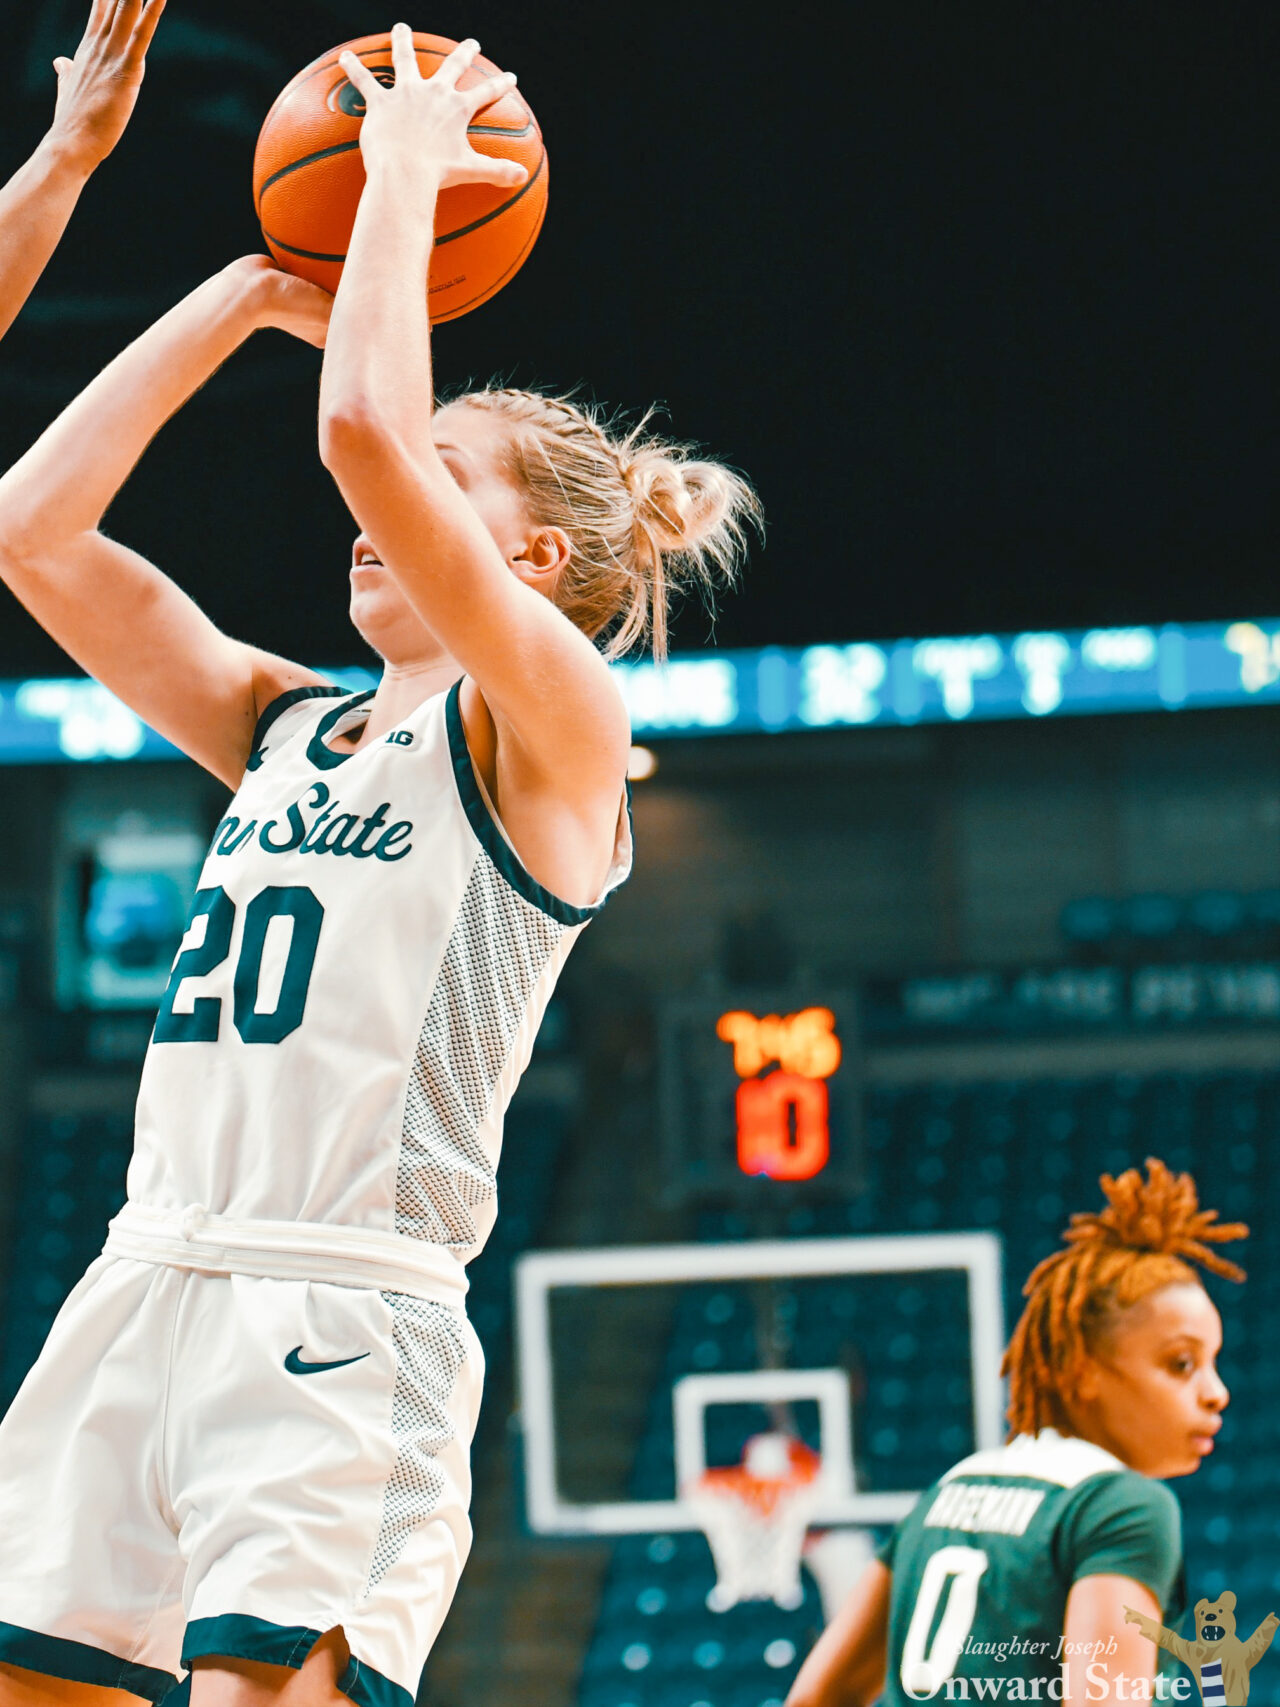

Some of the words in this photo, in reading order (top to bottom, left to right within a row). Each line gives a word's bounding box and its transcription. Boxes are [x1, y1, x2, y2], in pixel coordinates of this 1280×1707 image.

[259, 781, 414, 861] State
[152, 885, 324, 1044] 20
[900, 1545, 988, 1692] 0
